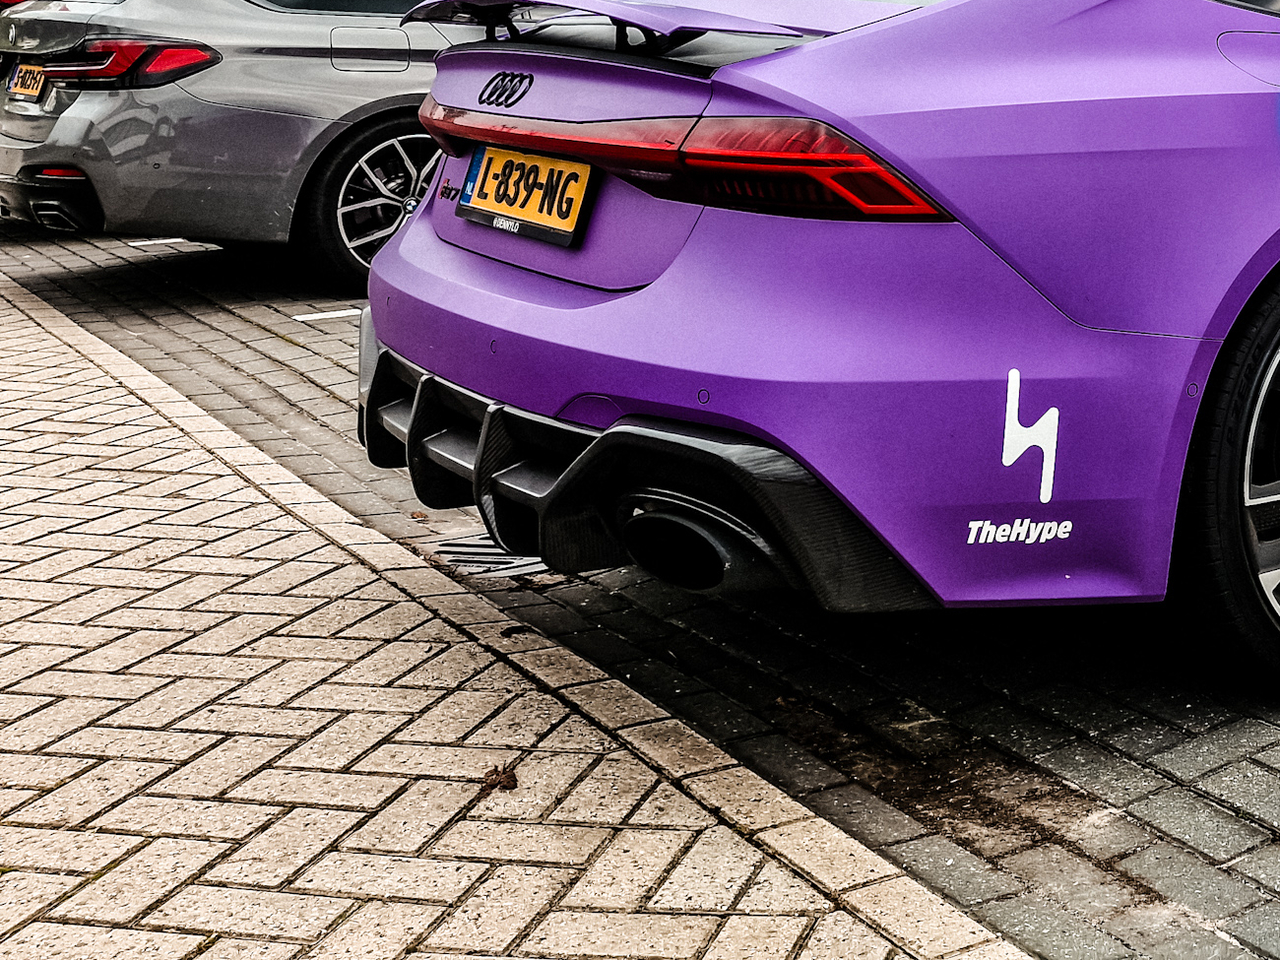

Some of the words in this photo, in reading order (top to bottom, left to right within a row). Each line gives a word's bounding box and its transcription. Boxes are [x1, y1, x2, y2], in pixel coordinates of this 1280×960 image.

[464, 181, 474, 196] NL
[476, 156, 580, 220] L-839-NG
[966, 518, 1073, 544] TheHype
